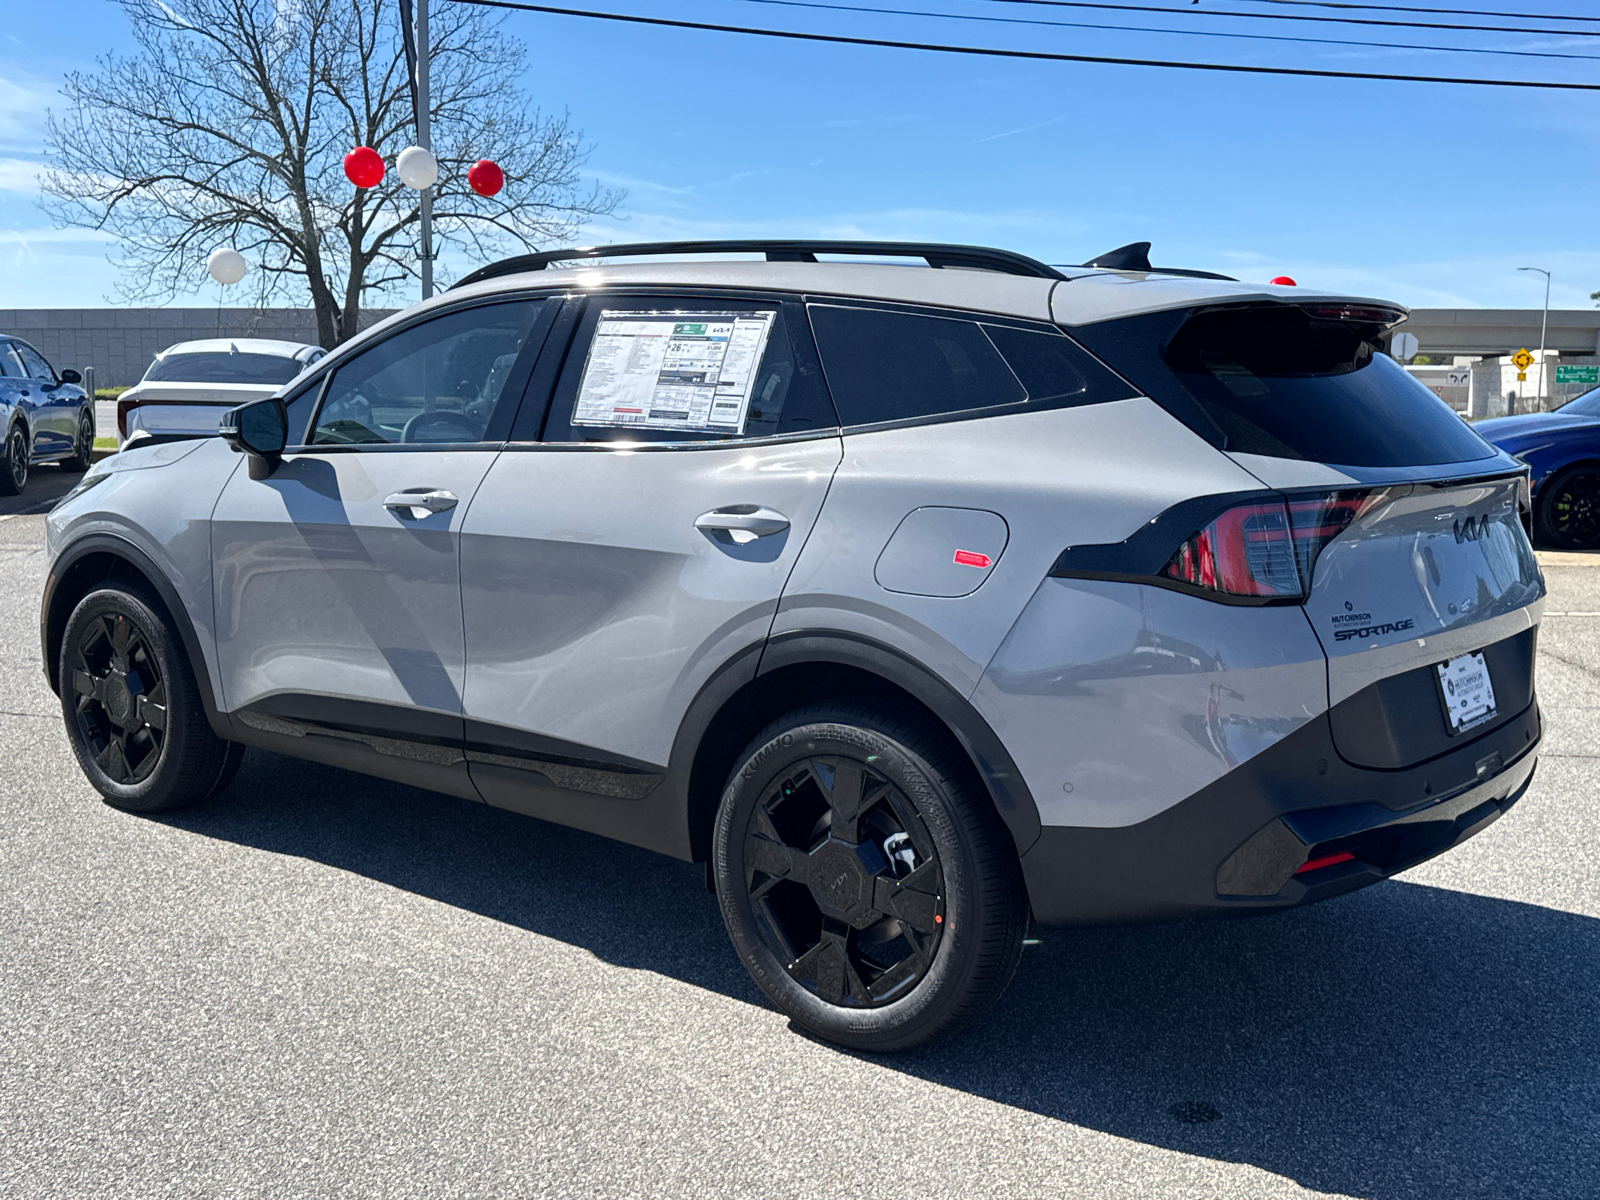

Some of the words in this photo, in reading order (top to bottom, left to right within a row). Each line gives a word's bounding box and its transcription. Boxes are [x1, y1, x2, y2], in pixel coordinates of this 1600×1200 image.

[671, 343, 682, 352] 26
[1453, 514, 1490, 544] KIA
[1331, 612, 1372, 624] HUTCHINSON
[1334, 619, 1415, 641] SPORTAGE
[741, 733, 794, 782] KUMHO
